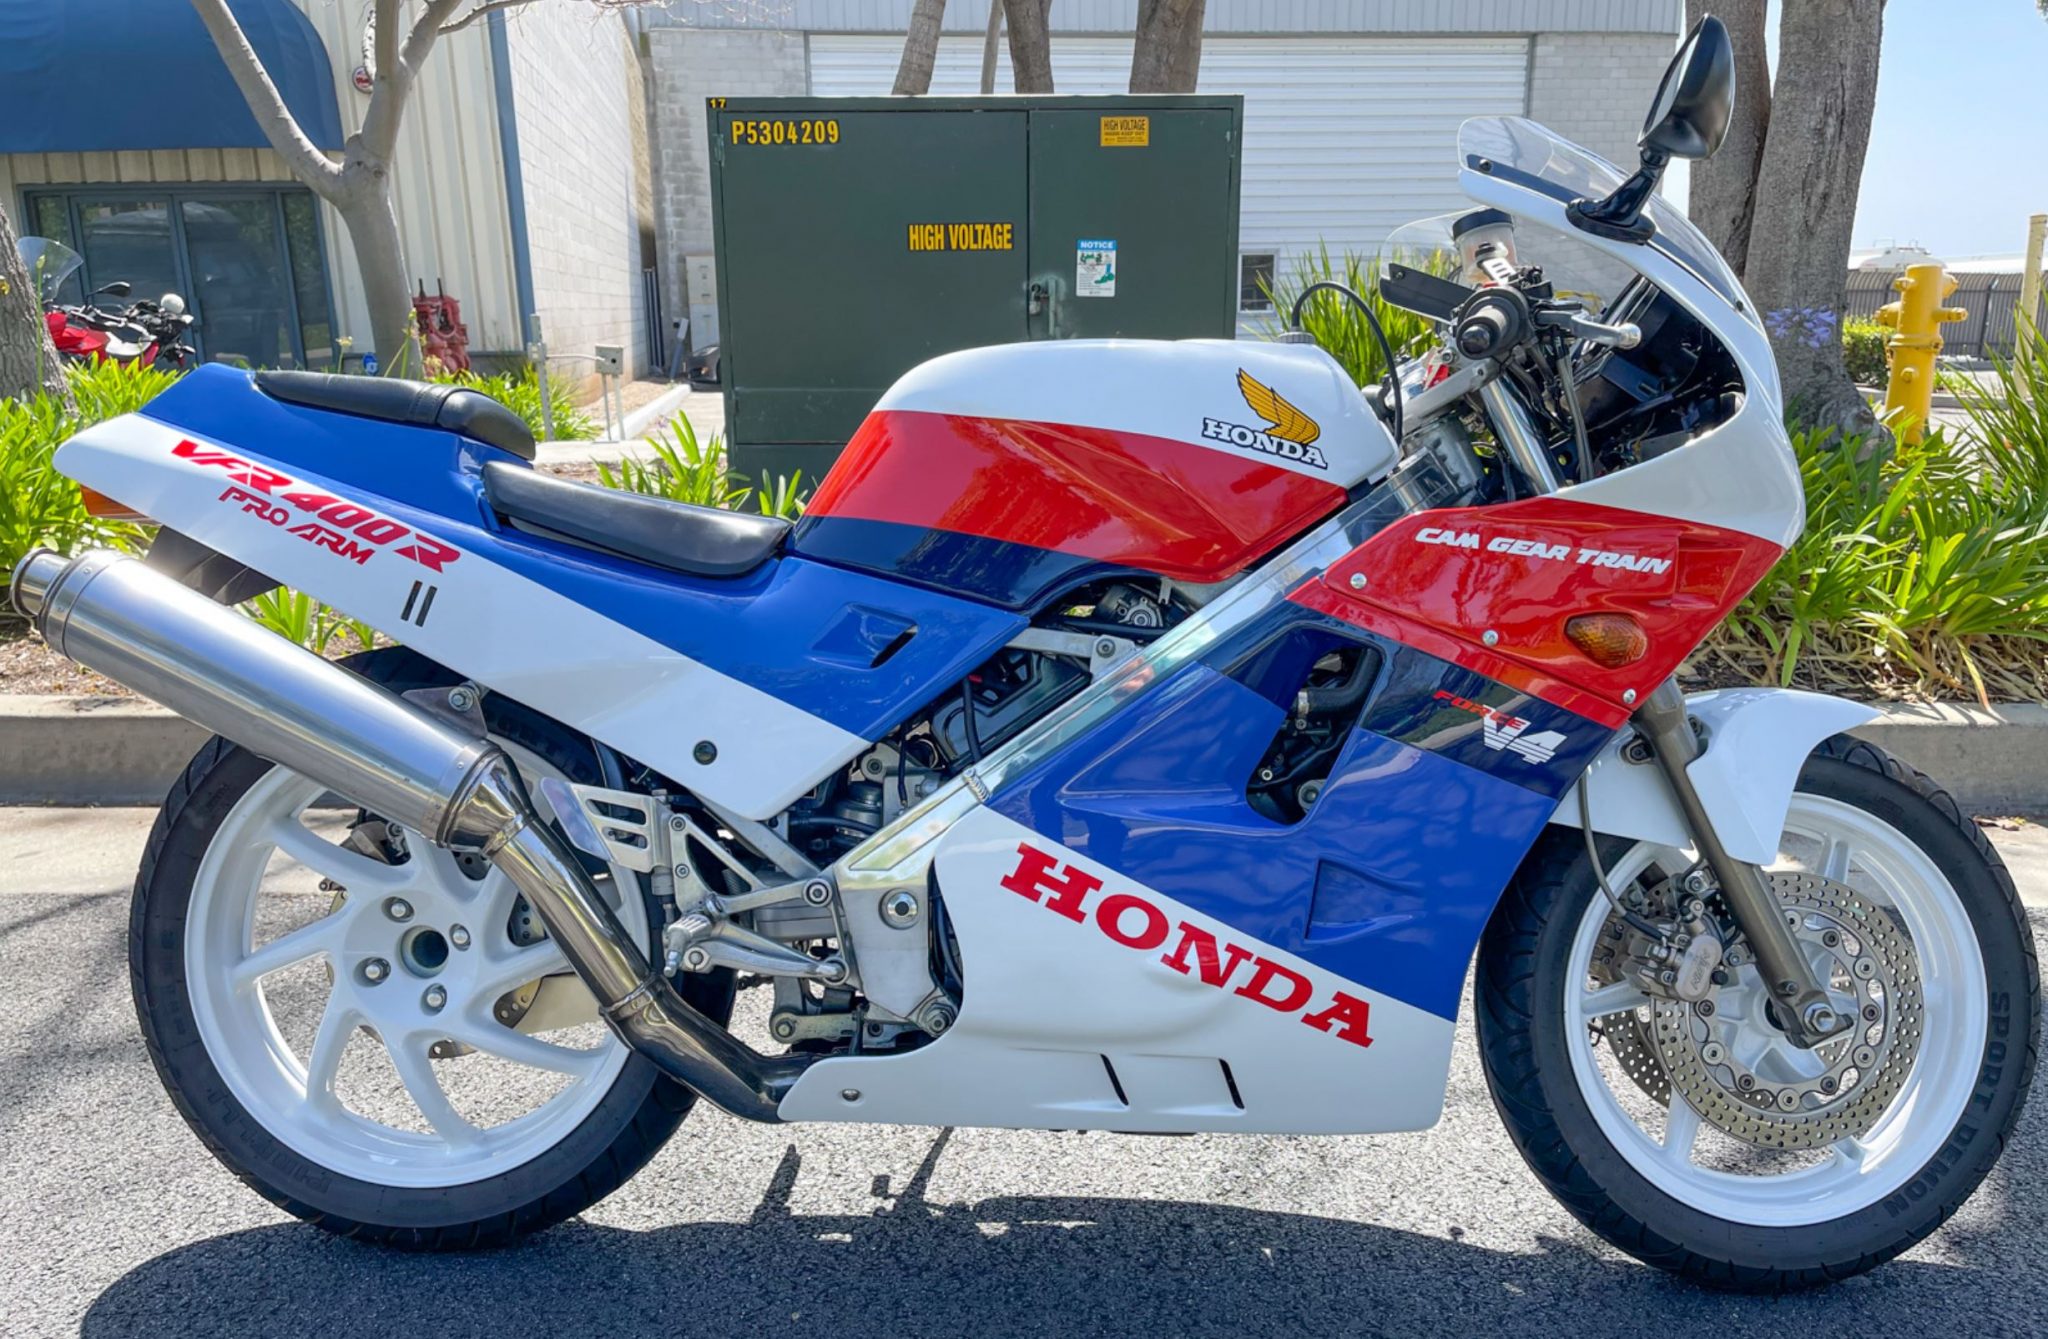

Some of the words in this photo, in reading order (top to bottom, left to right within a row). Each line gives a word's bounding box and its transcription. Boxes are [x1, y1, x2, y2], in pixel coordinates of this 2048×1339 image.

[710, 98, 726, 109] 17
[1104, 119, 1119, 131] HIGH
[1119, 119, 1145, 131] VOLTAGE
[731, 120, 839, 144] P5304209
[909, 224, 945, 250] HIGH
[948, 223, 1012, 249] VOLTAGE
[1080, 241, 1113, 249] NOTICE
[1202, 417, 1328, 470] HONDA
[218, 486, 290, 526] PRO
[286, 523, 376, 565] ARM
[1415, 527, 1480, 549] CAM
[1487, 537, 1571, 561] GEAR
[1576, 548, 1672, 574] TRAIN
[1482, 704, 1568, 765] V4
[1000, 842, 1373, 1048] HONDA
[1974, 992, 2010, 1112] SPORT
[1883, 1124, 1978, 1218] DEMON
